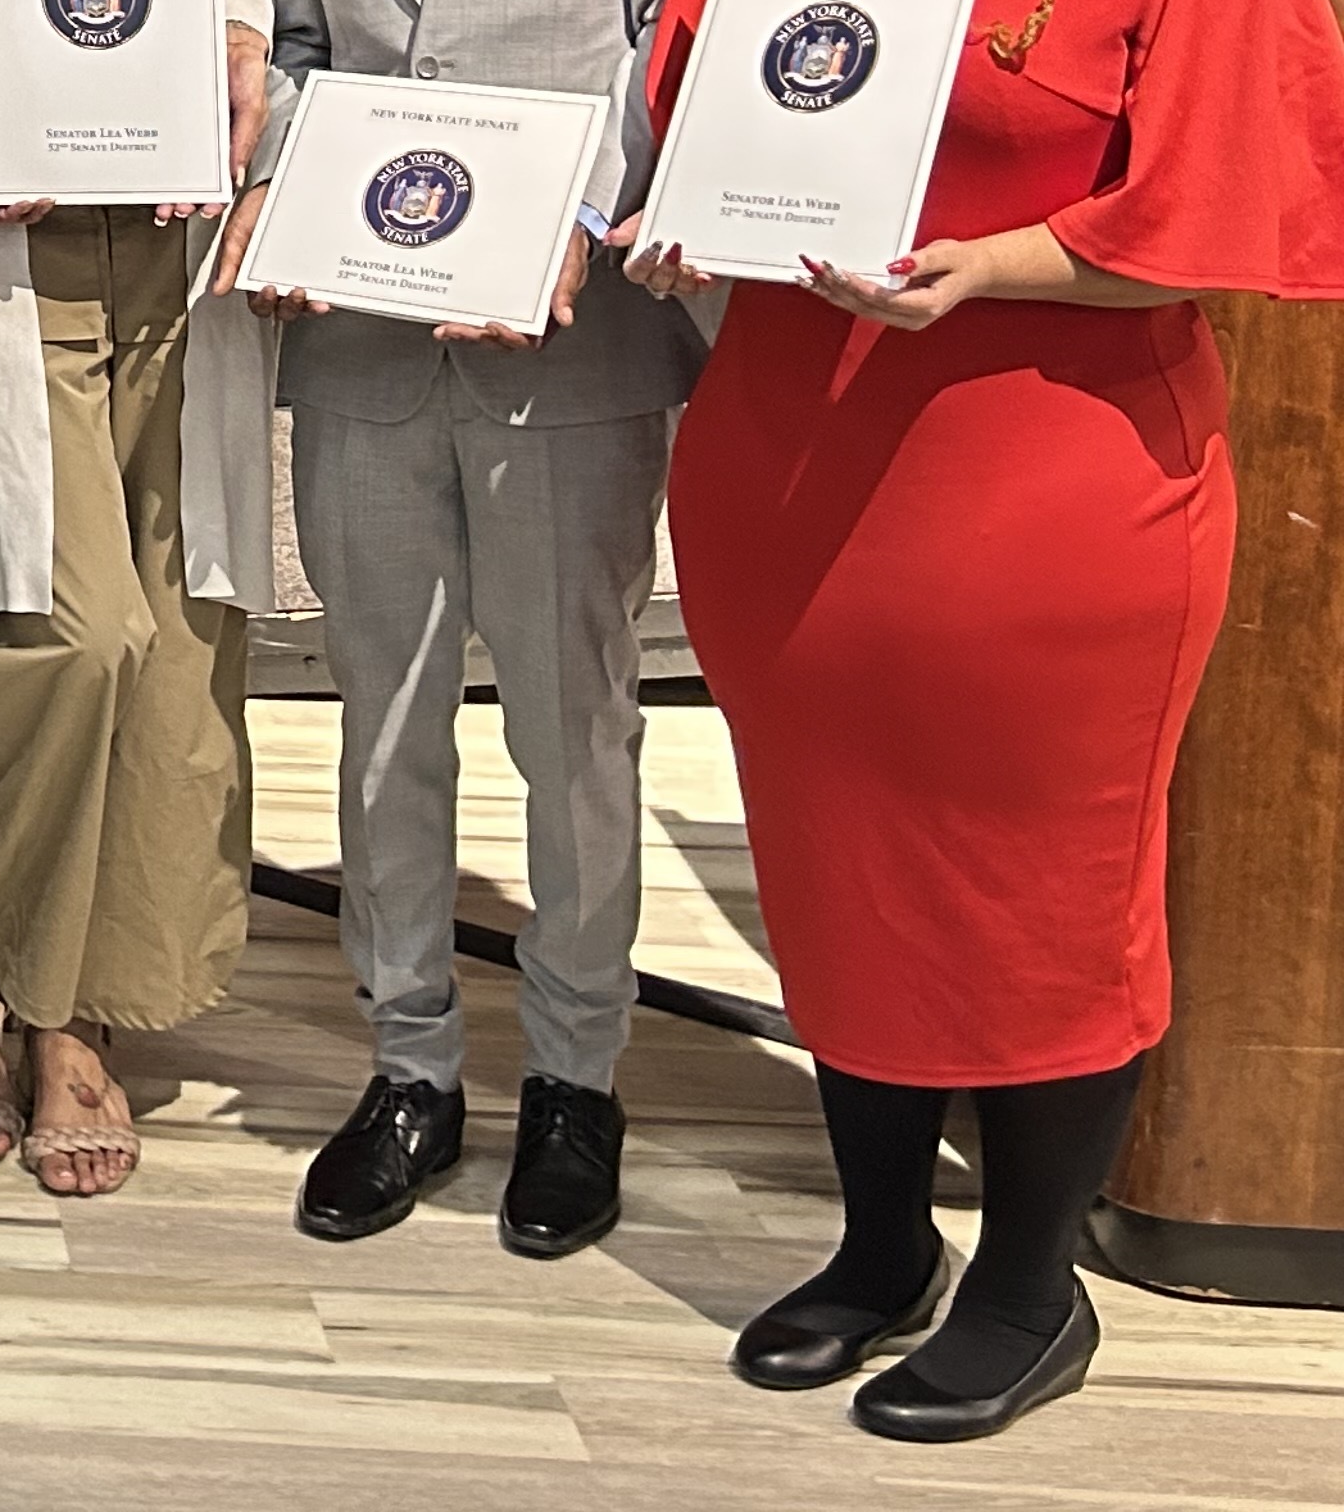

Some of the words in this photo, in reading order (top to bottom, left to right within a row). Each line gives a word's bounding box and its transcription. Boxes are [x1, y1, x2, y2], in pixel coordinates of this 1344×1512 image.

[72, 27, 121, 44] SENATE
[776, 13, 806, 44] NEW
[808, 6, 848, 21] YORK
[847, 12, 876, 47] STATE
[781, 90, 833, 108] SENATE
[370, 108, 398, 119] NEW
[402, 111, 433, 122] YORK
[436, 115, 472, 126] STATE
[475, 120, 520, 132] SENATE
[46, 128, 97, 138] SENATOR
[100, 128, 122, 138] LEA
[124, 128, 159, 138] WEBB
[70, 143, 107, 152] SENATE
[110, 143, 157, 152] DISTRICT
[377, 157, 405, 183] NEW
[408, 153, 446, 167] YORK
[446, 161, 469, 192] STATE
[722, 191, 775, 206] SENATOR
[778, 196, 801, 208] LEA
[806, 198, 841, 211] WEBB
[743, 209, 782, 221] SENATE
[784, 212, 836, 226] DISTRICT
[381, 226, 429, 245] SENATE
[340, 256, 391, 272] SENATOR
[394, 263, 415, 276] LEA
[420, 267, 454, 281] WEBB
[360, 273, 397, 287] SENATE
[400, 279, 448, 294] DISTRICT
